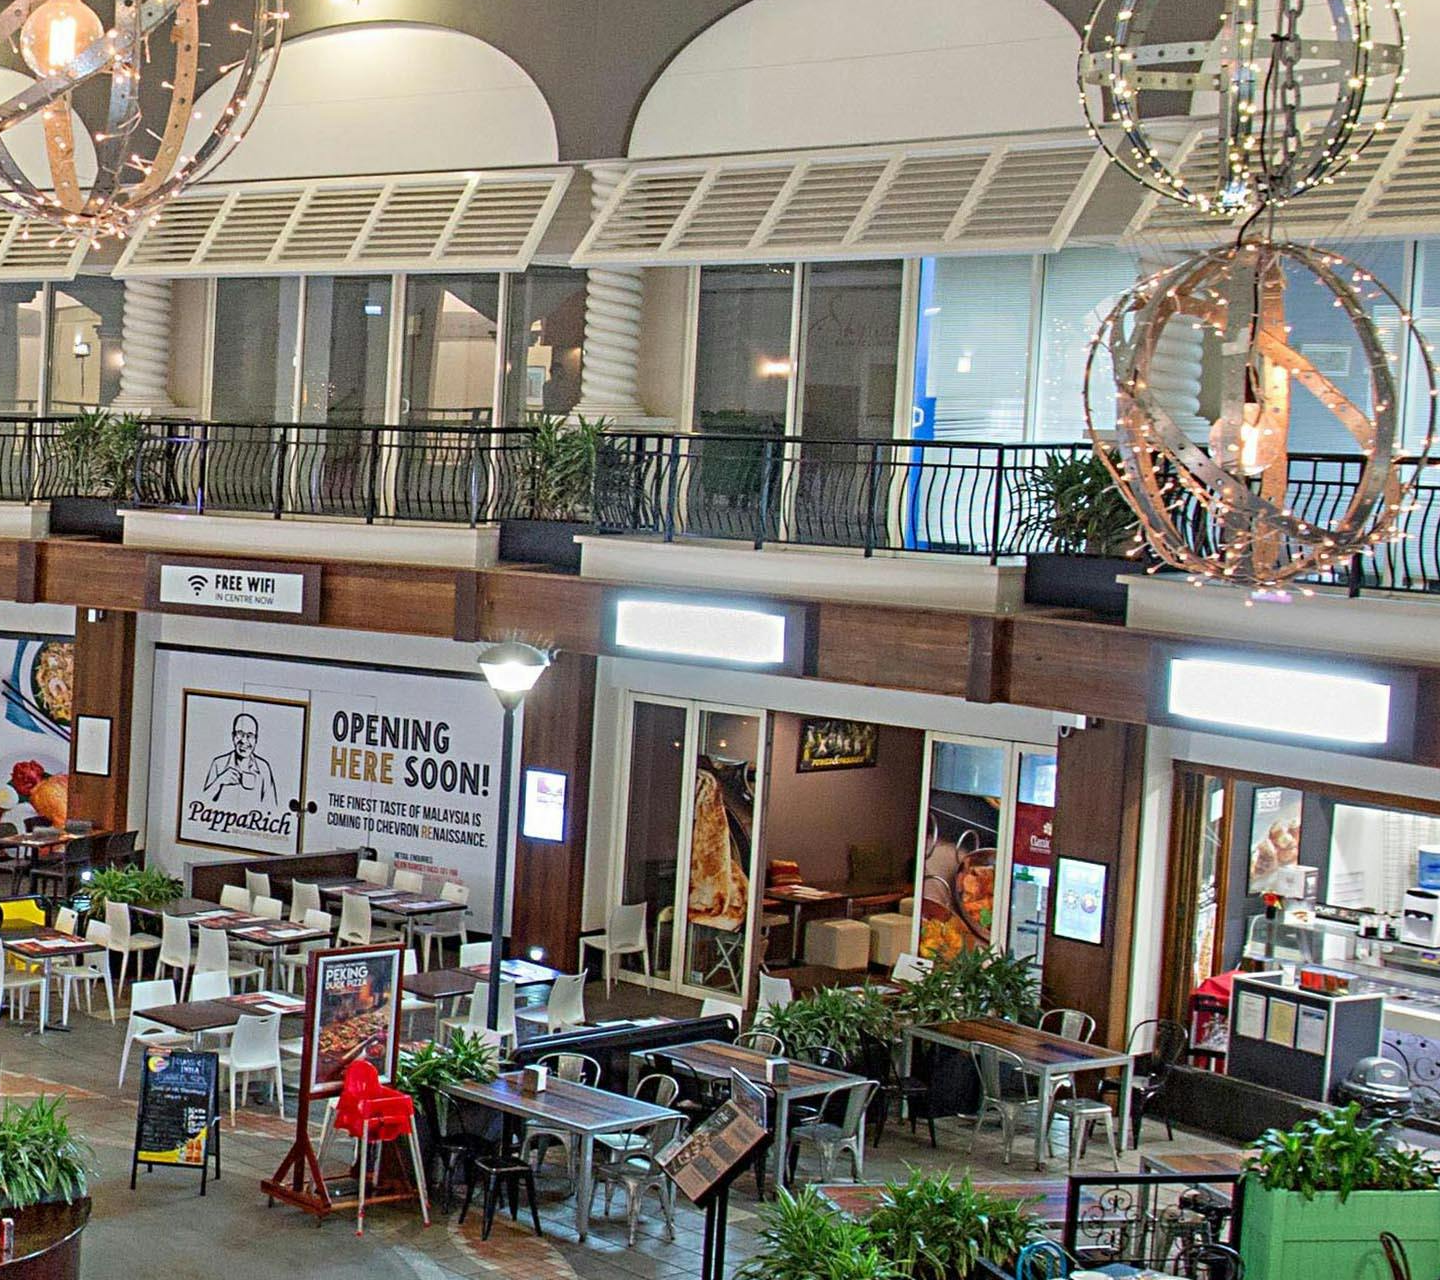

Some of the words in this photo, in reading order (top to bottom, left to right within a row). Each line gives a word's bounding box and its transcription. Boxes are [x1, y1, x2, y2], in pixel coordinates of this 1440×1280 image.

[215, 574, 242, 591] FREE
[247, 576, 275, 594] WIFI
[216, 593, 223, 601] IN
[224, 594, 253, 604] CENTRE
[254, 596, 274, 605] NOW
[332, 710, 450, 754] OPENING
[330, 745, 394, 785] HERE
[404, 755, 490, 797] SOON!
[188, 800, 291, 835] PappaRich
[328, 792, 345, 808] THE
[346, 796, 378, 813] FINEST
[379, 800, 407, 817] TASTE
[409, 804, 422, 819] OF
[422, 806, 469, 826] MALAYSIA
[472, 812, 482, 827] IS
[327, 812, 361, 829] COMING
[363, 816, 375, 832] TO
[376, 819, 419, 838] CHEVRON
[420, 825, 488, 849] RENAISSANCE.
[324, 981, 345, 990] DUCK
[325, 966, 369, 982] PEKING
